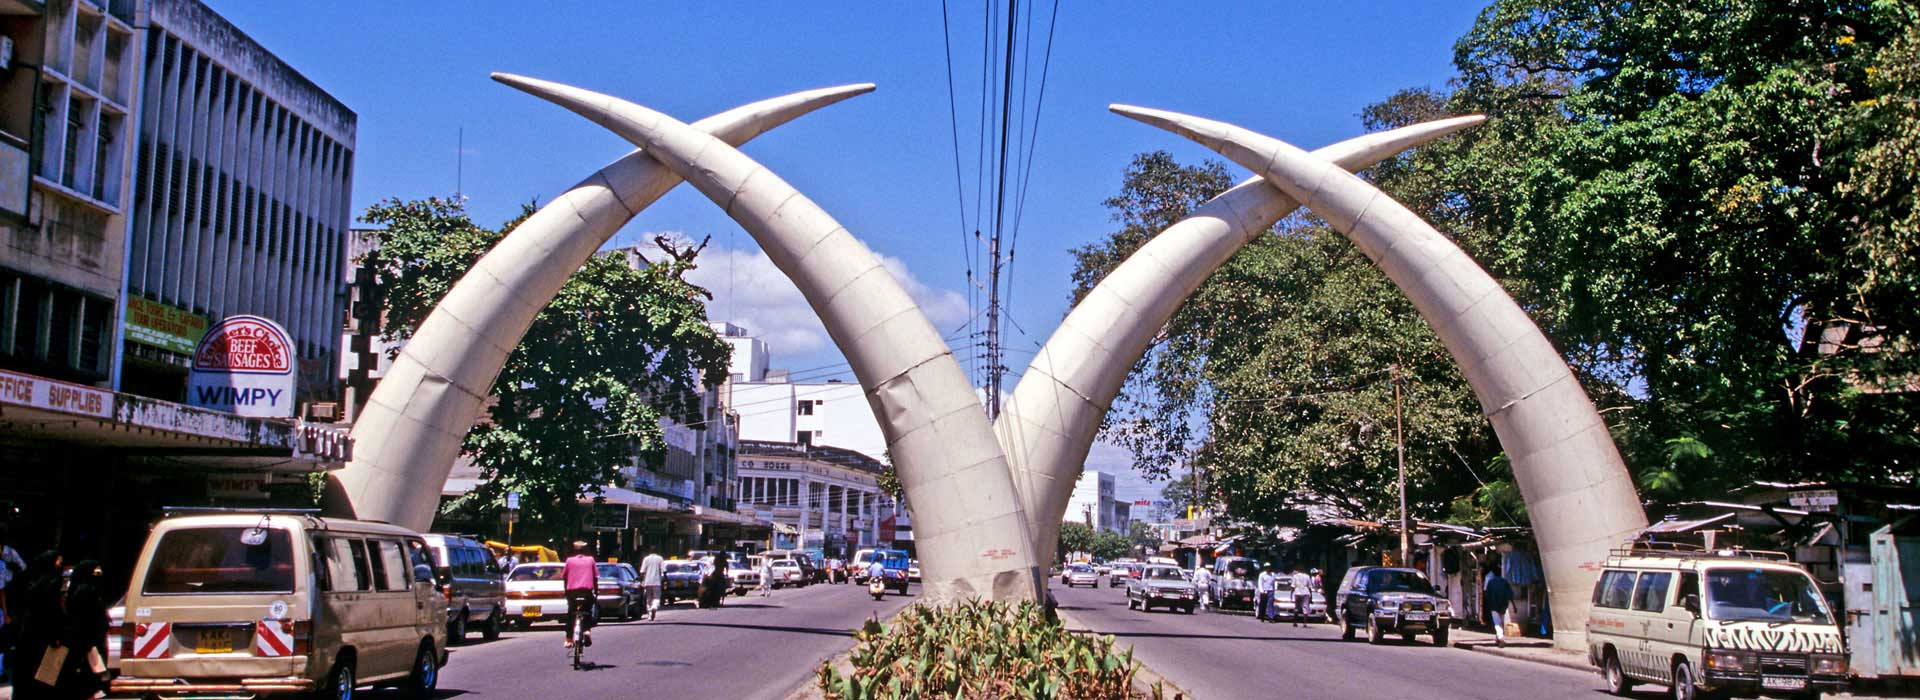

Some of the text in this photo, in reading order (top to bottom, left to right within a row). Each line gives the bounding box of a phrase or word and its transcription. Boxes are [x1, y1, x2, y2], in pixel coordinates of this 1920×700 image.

[230, 338, 258, 353] BEEF
[253, 327, 283, 368] Choice
[213, 352, 271, 368] SAUSAGES
[49, 384, 102, 414] SUPPLIES
[197, 386, 282, 407] WIMPY
